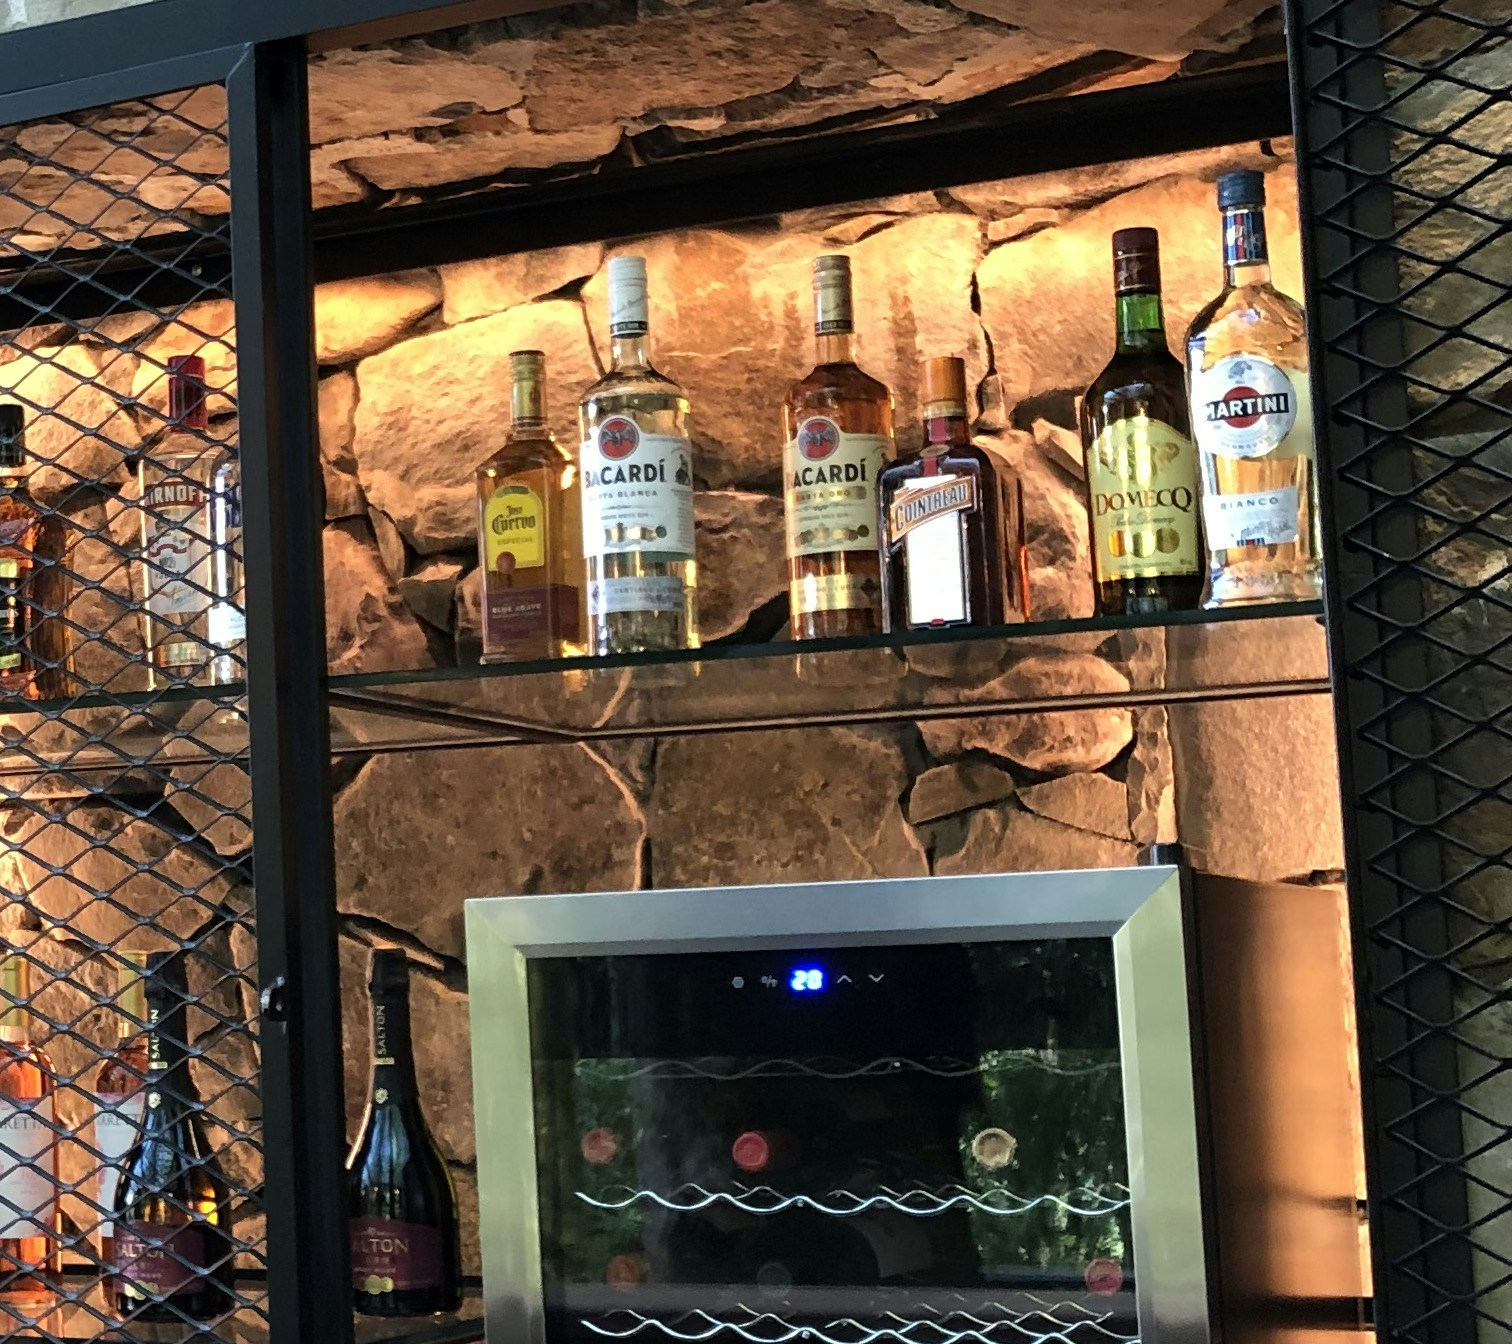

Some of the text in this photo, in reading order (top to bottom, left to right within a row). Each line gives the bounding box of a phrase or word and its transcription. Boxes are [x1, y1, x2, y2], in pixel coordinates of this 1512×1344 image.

[792, 458, 867, 489] ACARDÍ
[894, 482, 969, 532] COINTREAU
[1094, 486, 1194, 517] DOMECQ
[1220, 496, 1280, 510] BIANCO
[491, 514, 537, 536] Cuervo
[375, 1005, 387, 1056] SALTON
